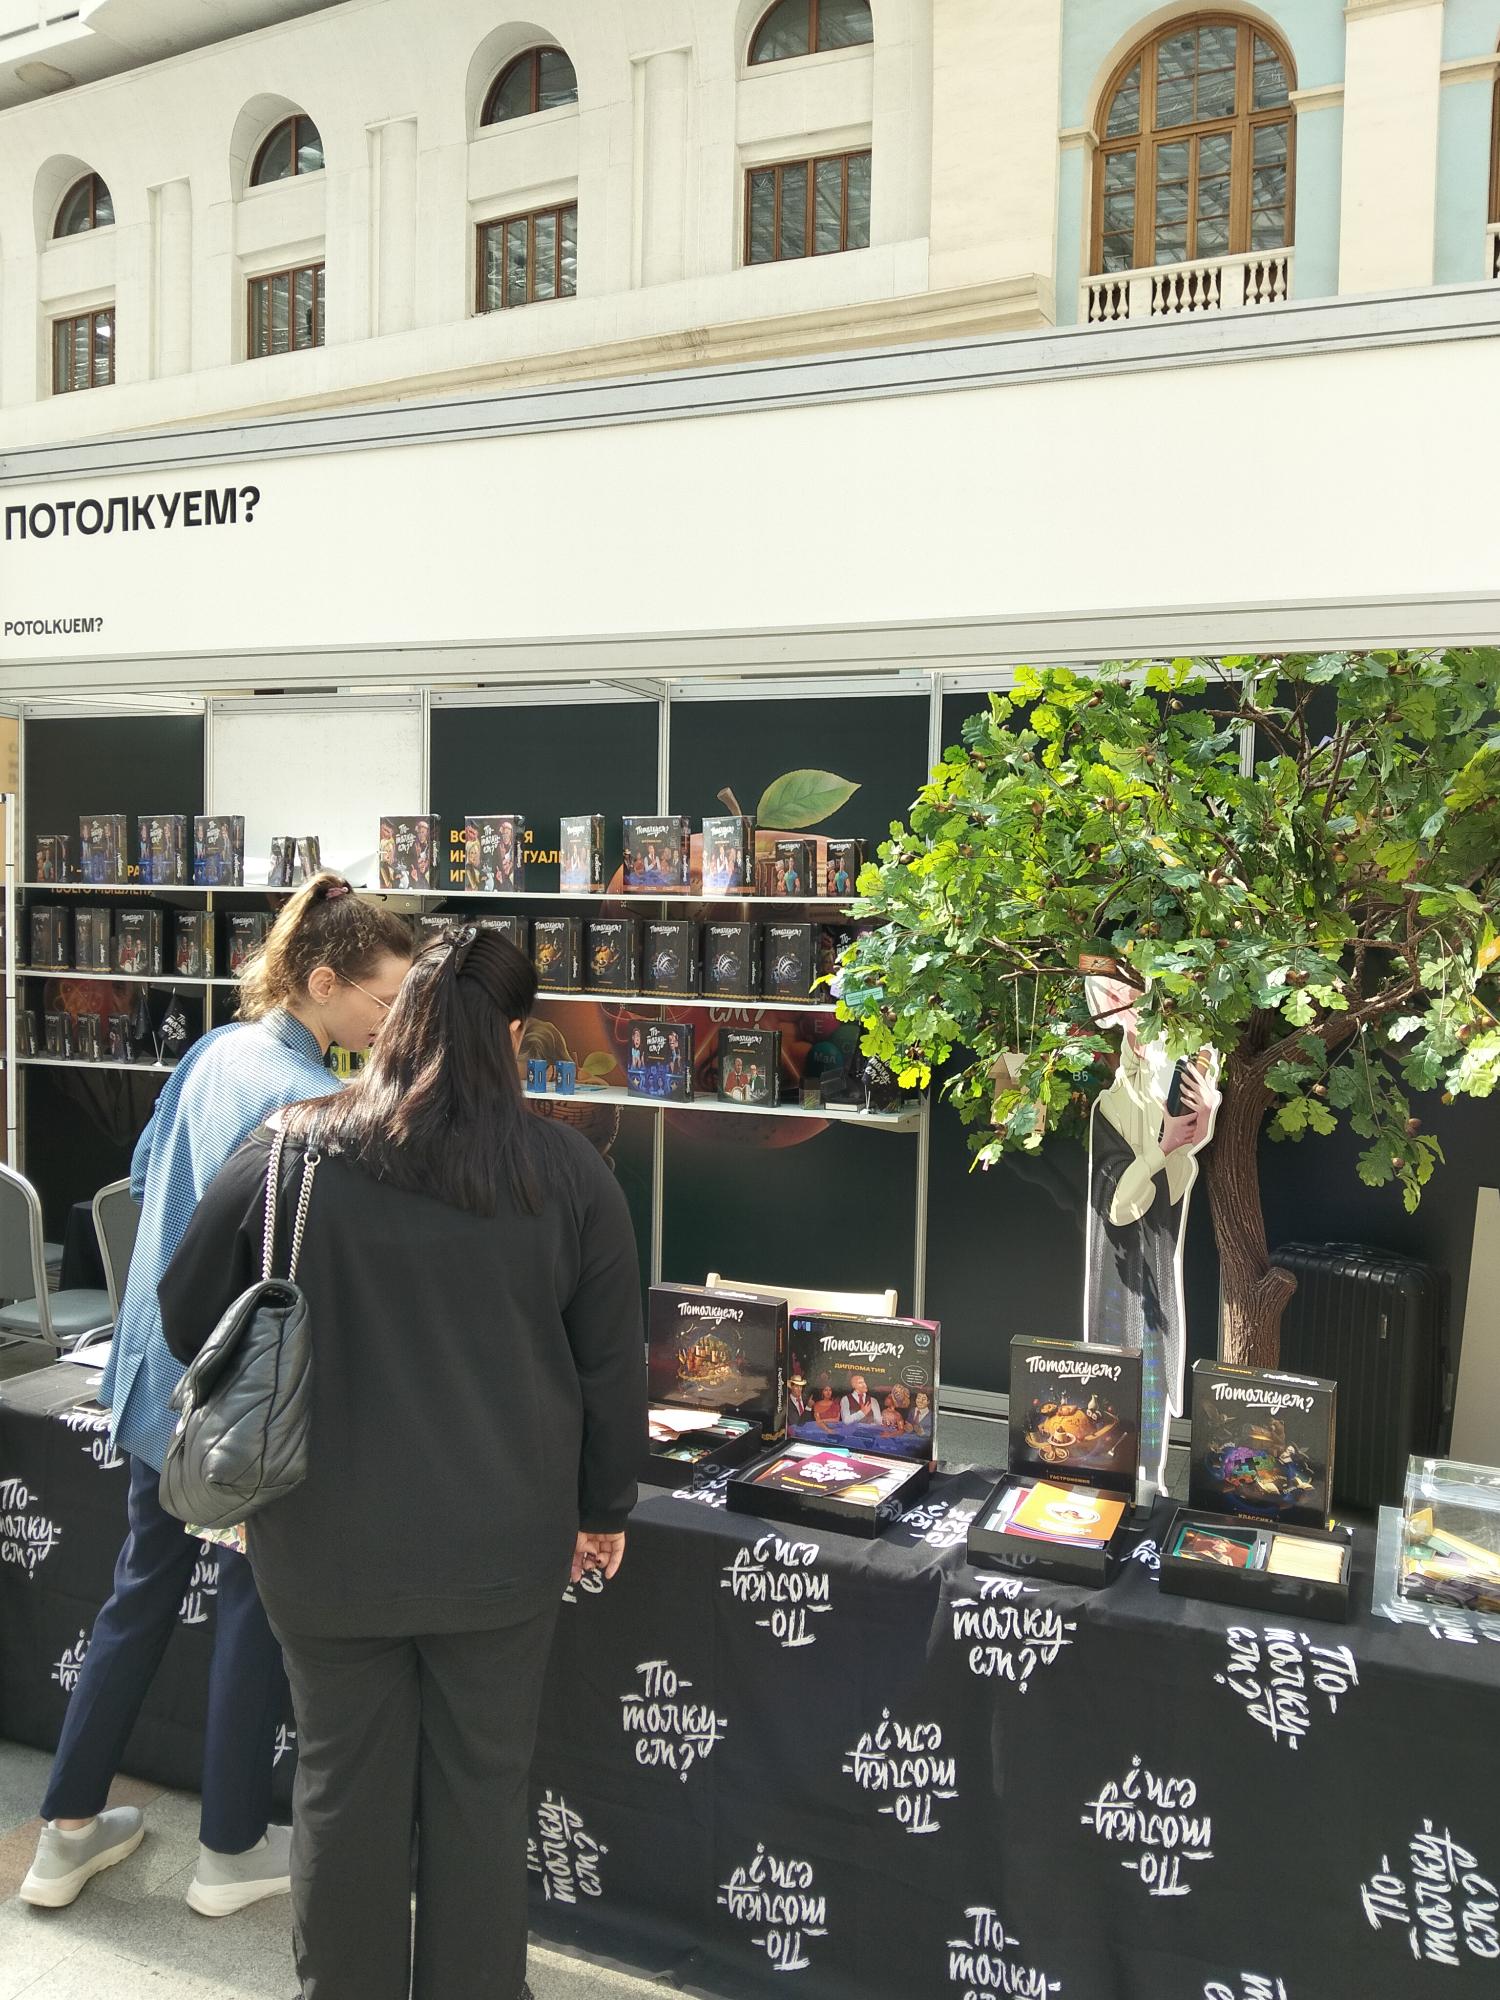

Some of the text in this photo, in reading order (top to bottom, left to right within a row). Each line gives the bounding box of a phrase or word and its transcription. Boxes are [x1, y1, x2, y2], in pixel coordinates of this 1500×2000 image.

[5, 486, 260, 540] ПОТОЛКУЕМ?
[4, 617, 103, 636] POTOLKUEM?
[677, 1301, 744, 1325] Потолкуем?
[819, 1335, 905, 1361] Потолкуем?
[834, 1362, 886, 1374] ДИПЛОМАТИЯ
[1025, 1355, 1122, 1383] Потолкуем?
[1211, 1383, 1314, 1416] Потолкуем?
[753, 1533, 820, 1566] ем?
[720, 1548, 833, 1613] толку-
[974, 1575, 1041, 1601] По-
[755, 1608, 816, 1647] По-
[950, 1598, 1078, 1666] толку-
[635, 1660, 693, 1698] По-
[968, 1646, 1037, 1694] ем?
[1213, 1626, 1262, 1700] ем?
[1246, 1627, 1311, 1750] толку-
[620, 1693, 728, 1759] толку-
[875, 1706, 942, 1752] ем?
[635, 1739, 695, 1784] ем?
[842, 1732, 959, 1798] толку-
[1122, 1754, 1197, 1808] ем?
[877, 1794, 941, 1834] По-
[1080, 1781, 1214, 1860] толку-
[536, 1789, 585, 1905] толку-
[750, 1841, 813, 1888] ем?
[1120, 1852, 1192, 1896] По-
[1360, 1854, 1410, 1931] По-
[1408, 1818, 1479, 1967] толку-
[716, 1866, 829, 1936] толку-
[751, 1930, 811, 1971] По-
[964, 1907, 1020, 1952] По-
